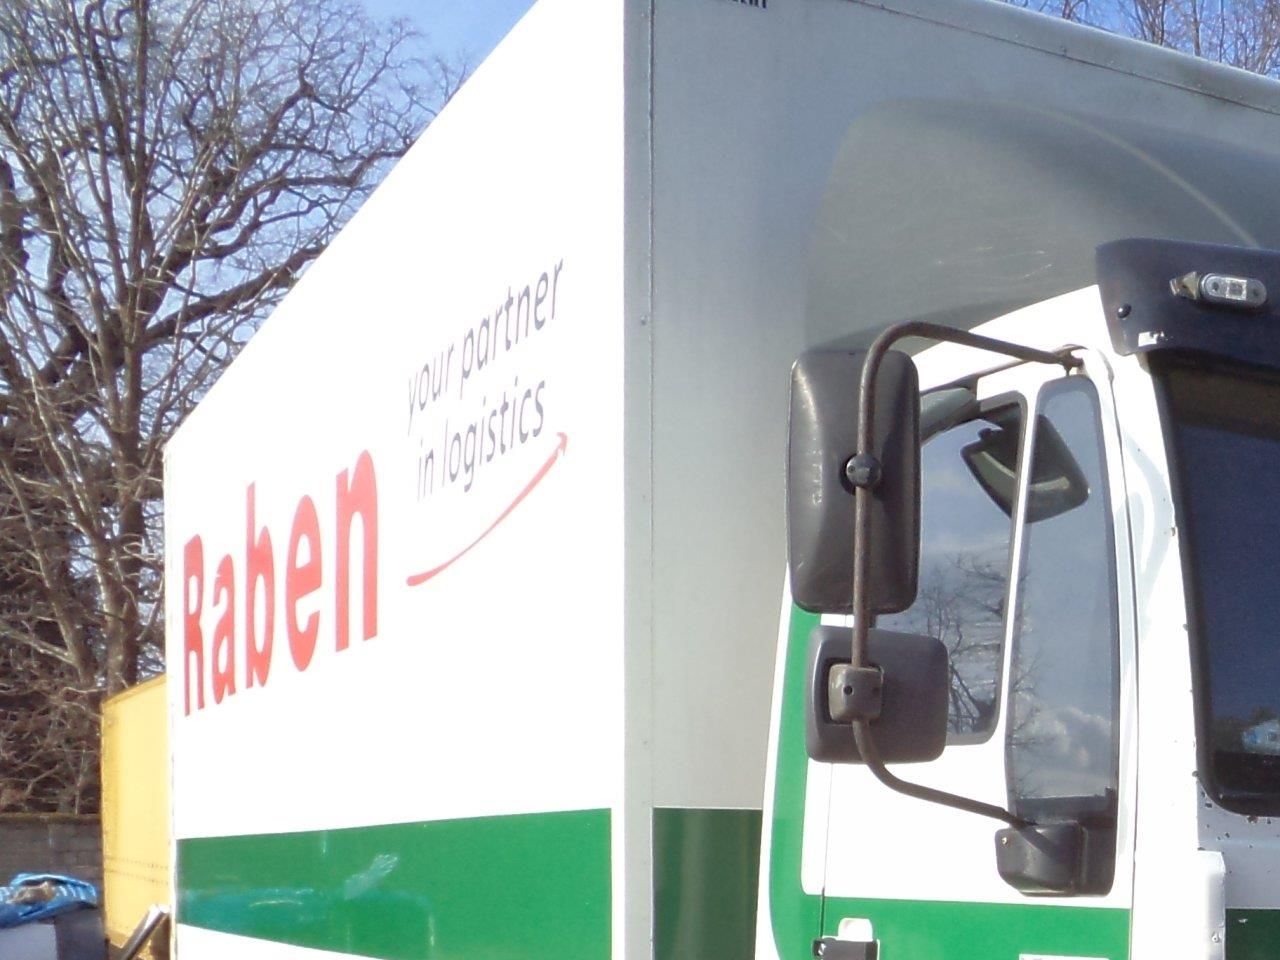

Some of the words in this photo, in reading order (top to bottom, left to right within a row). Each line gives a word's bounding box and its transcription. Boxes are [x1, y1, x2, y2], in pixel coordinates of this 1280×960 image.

[408, 343, 454, 436] your
[461, 258, 564, 399] partner
[417, 440, 435, 502] in
[443, 375, 546, 493] logistics
[183, 448, 379, 718] Raben
